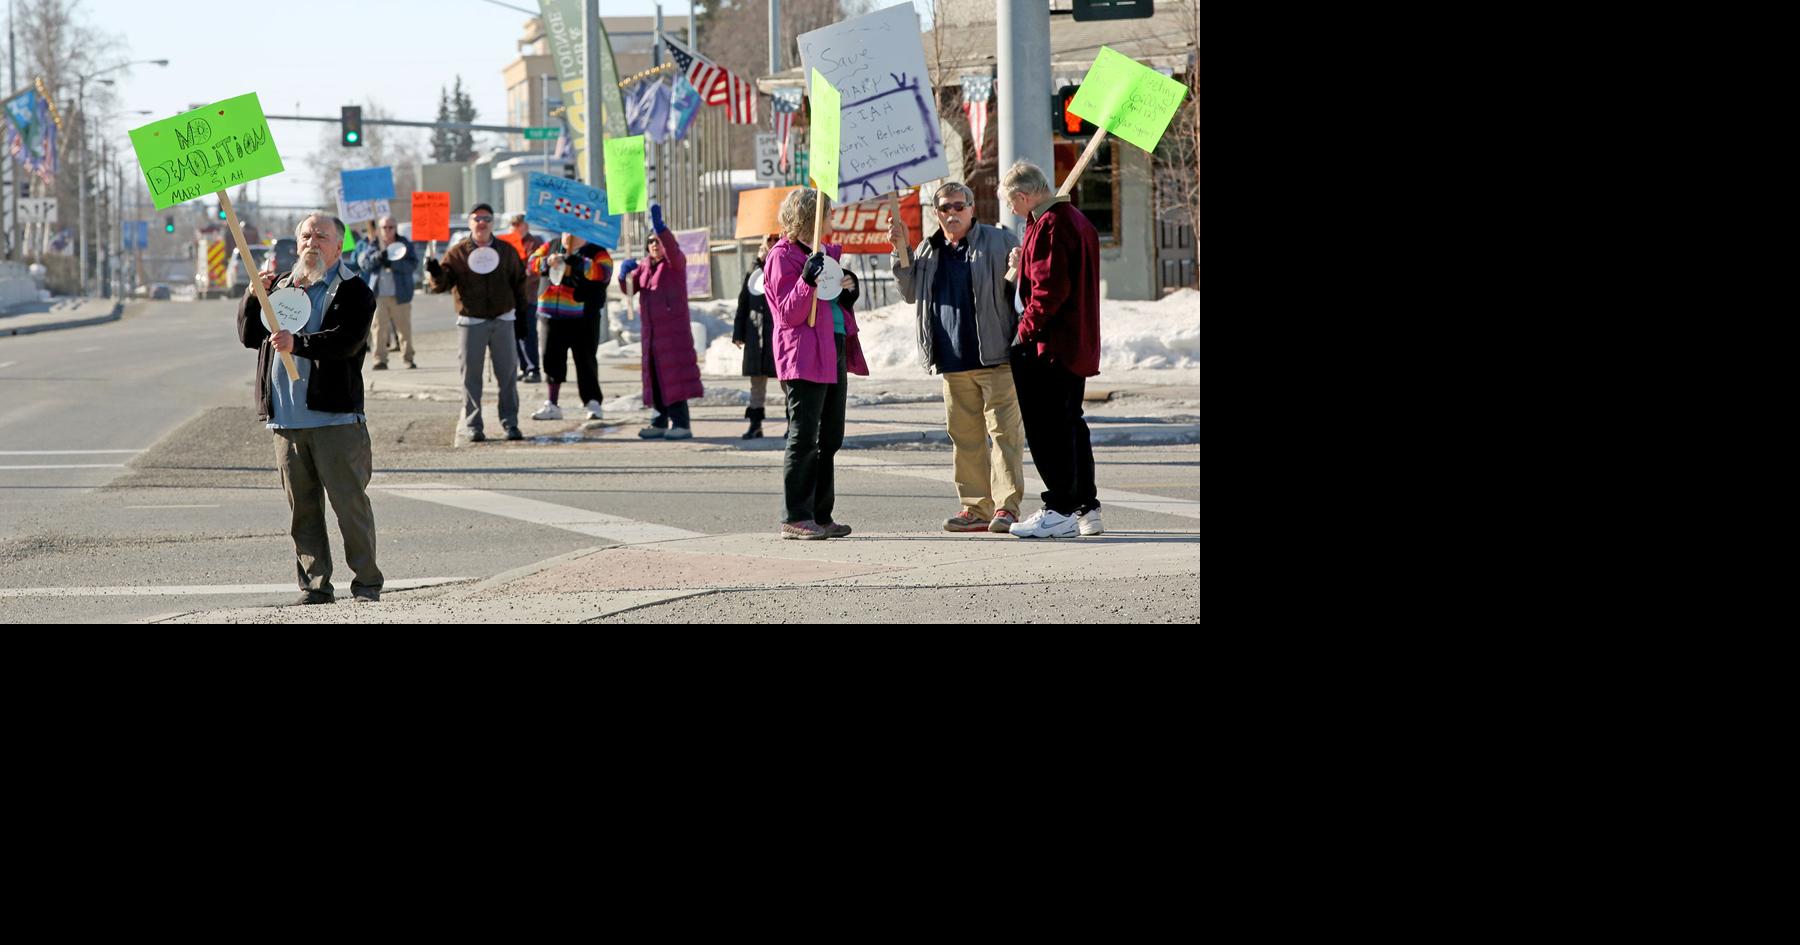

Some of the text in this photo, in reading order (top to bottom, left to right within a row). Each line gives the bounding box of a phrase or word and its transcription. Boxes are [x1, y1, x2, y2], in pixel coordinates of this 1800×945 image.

[821, 47, 874, 75] Save
[175, 117, 211, 150] NO
[172, 184, 200, 203] MARY
[538, 192, 608, 227] POOL
[832, 231, 890, 244] LIVES HER
